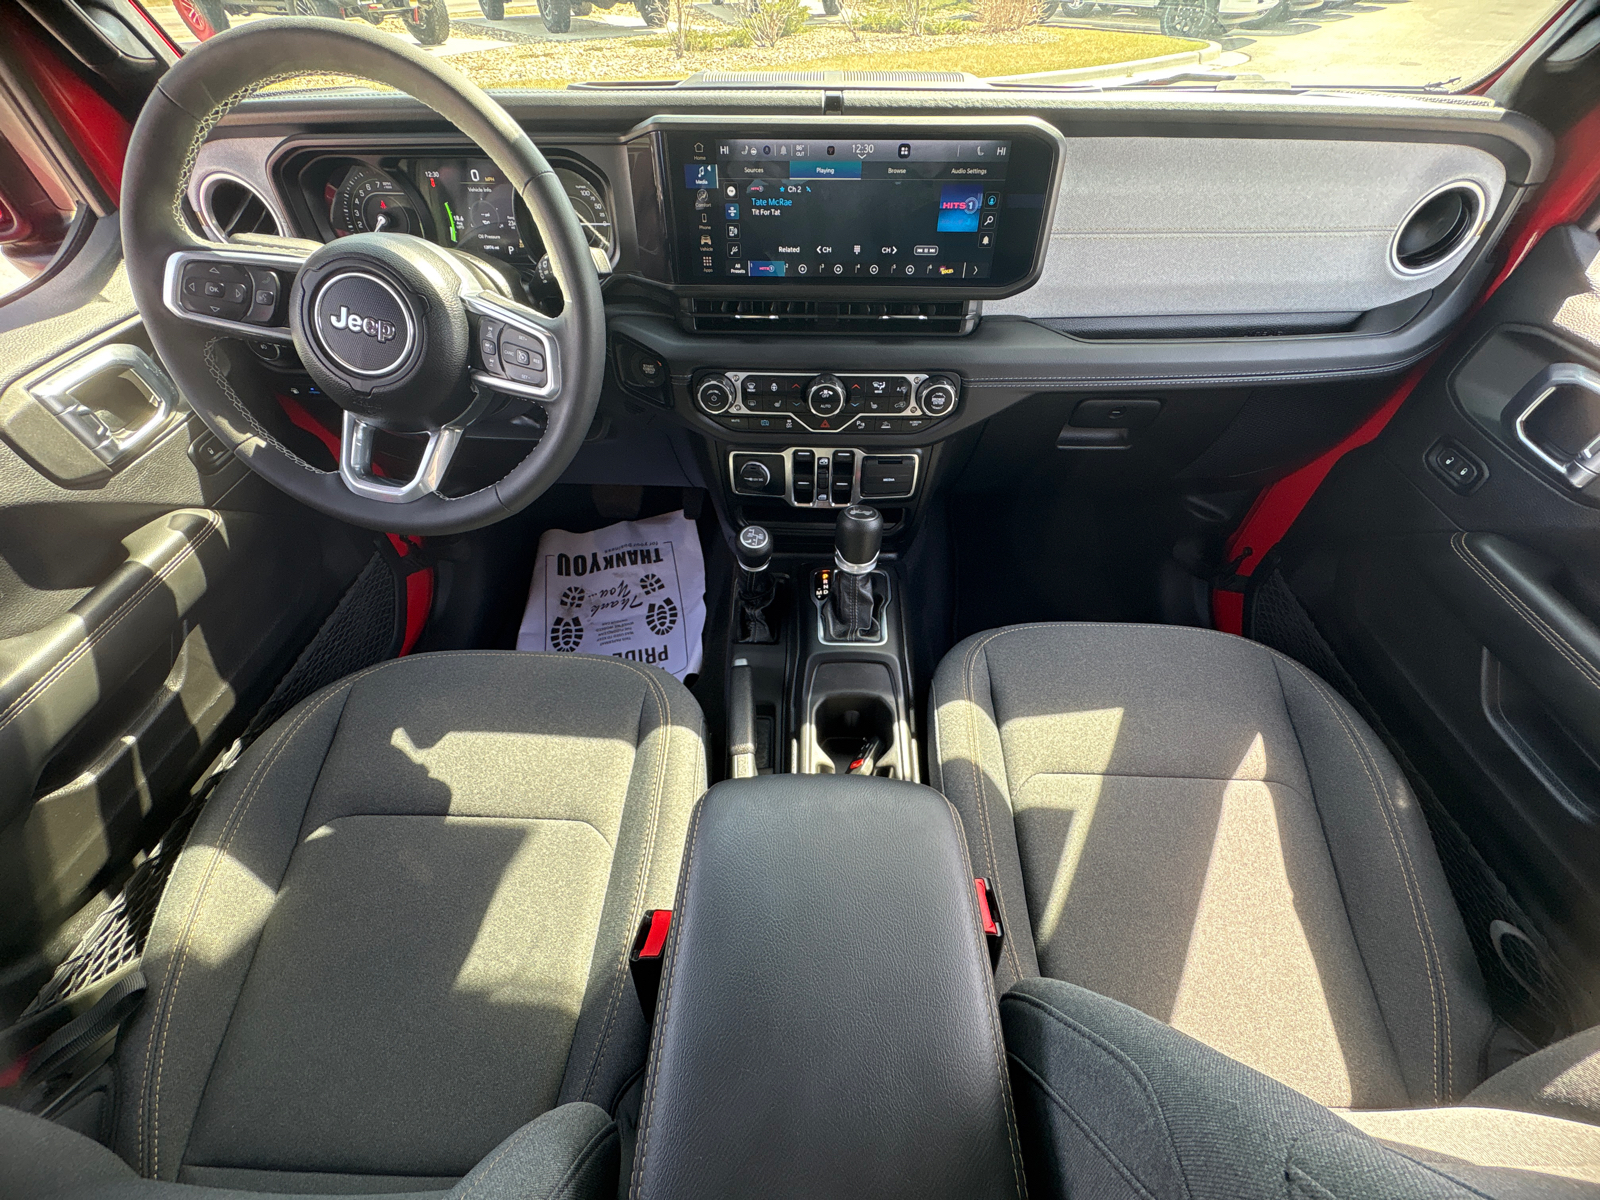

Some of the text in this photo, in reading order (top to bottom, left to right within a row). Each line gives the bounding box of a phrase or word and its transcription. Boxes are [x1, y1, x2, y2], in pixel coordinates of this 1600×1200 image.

[720, 145, 729, 154] HI
[852, 144, 874, 154] 12:30
[997, 147, 1006, 156] HI
[470, 169, 480, 182] 0
[768, 198, 792, 206] McRae
[508, 246, 514, 254] P
[330, 306, 396, 344] Jeep
[590, 596, 644, 618] Thank
